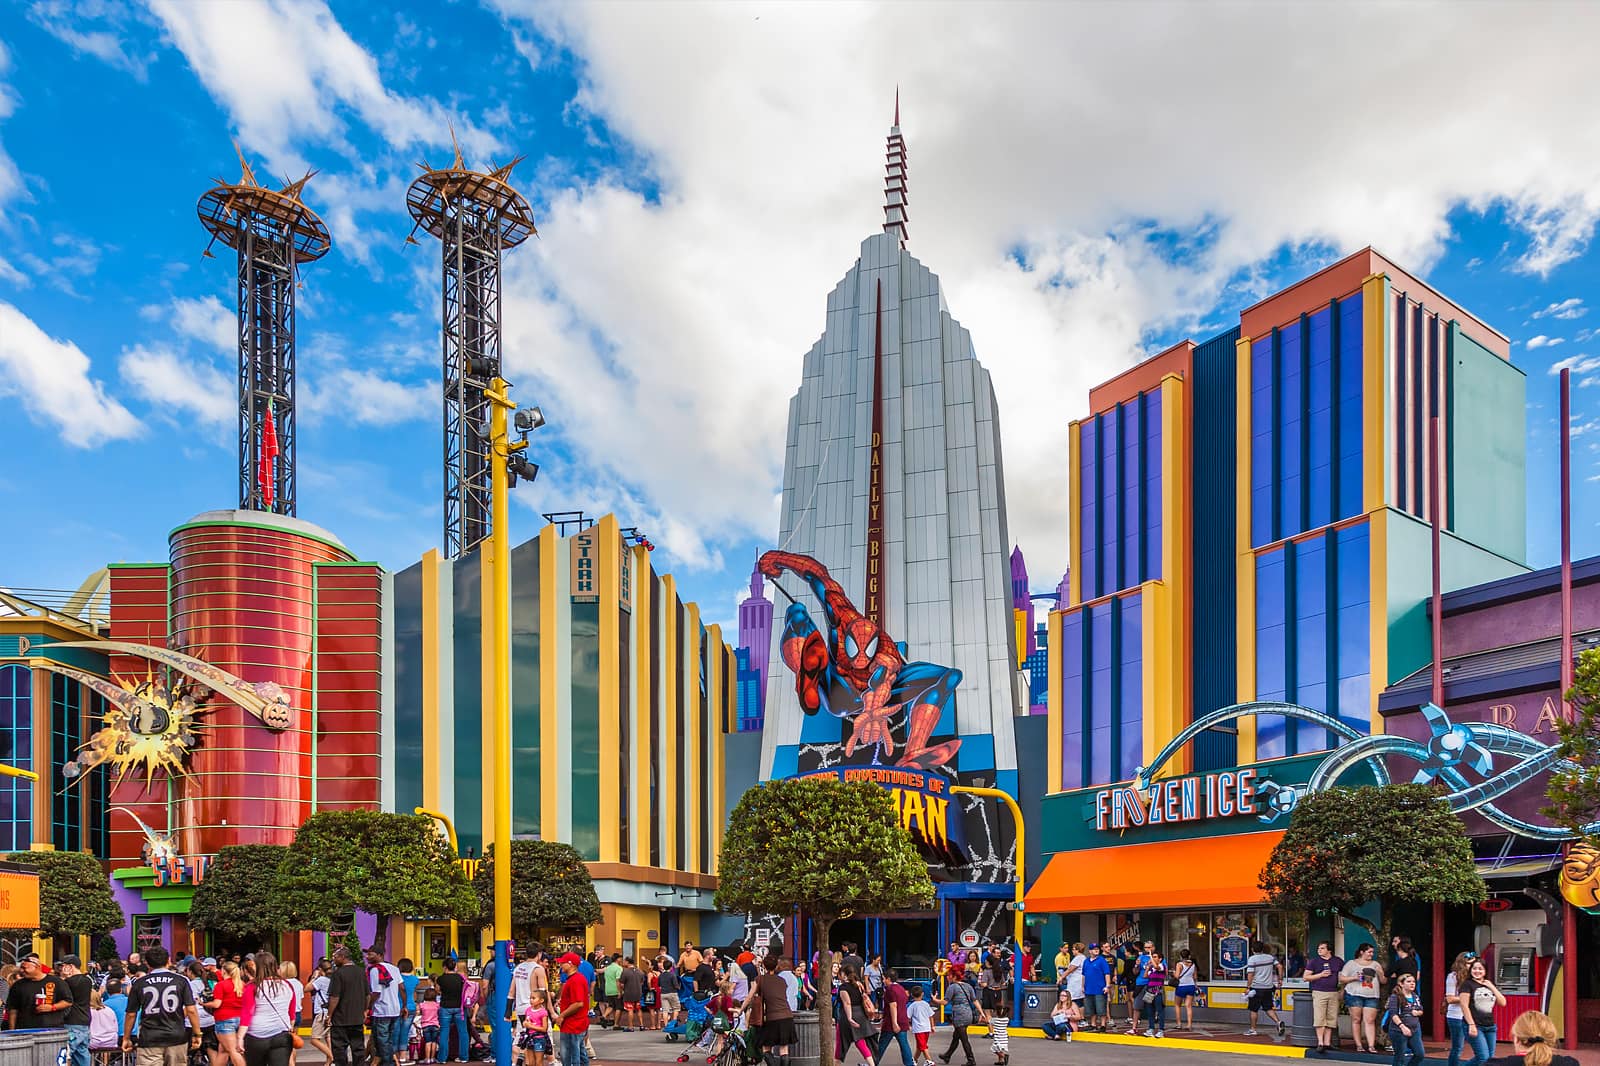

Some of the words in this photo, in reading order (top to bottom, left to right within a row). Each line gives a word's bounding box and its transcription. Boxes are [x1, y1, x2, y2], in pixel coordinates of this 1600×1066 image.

[871, 432, 881, 521] DAILY
[845, 769, 924, 788] ADVENTURES
[928, 777, 945, 794] OF
[1096, 777, 1200, 830] FROZEN
[1206, 768, 1257, 818] ICE
[145, 976, 174, 985] TERRY
[143, 985, 179, 1015] 26
